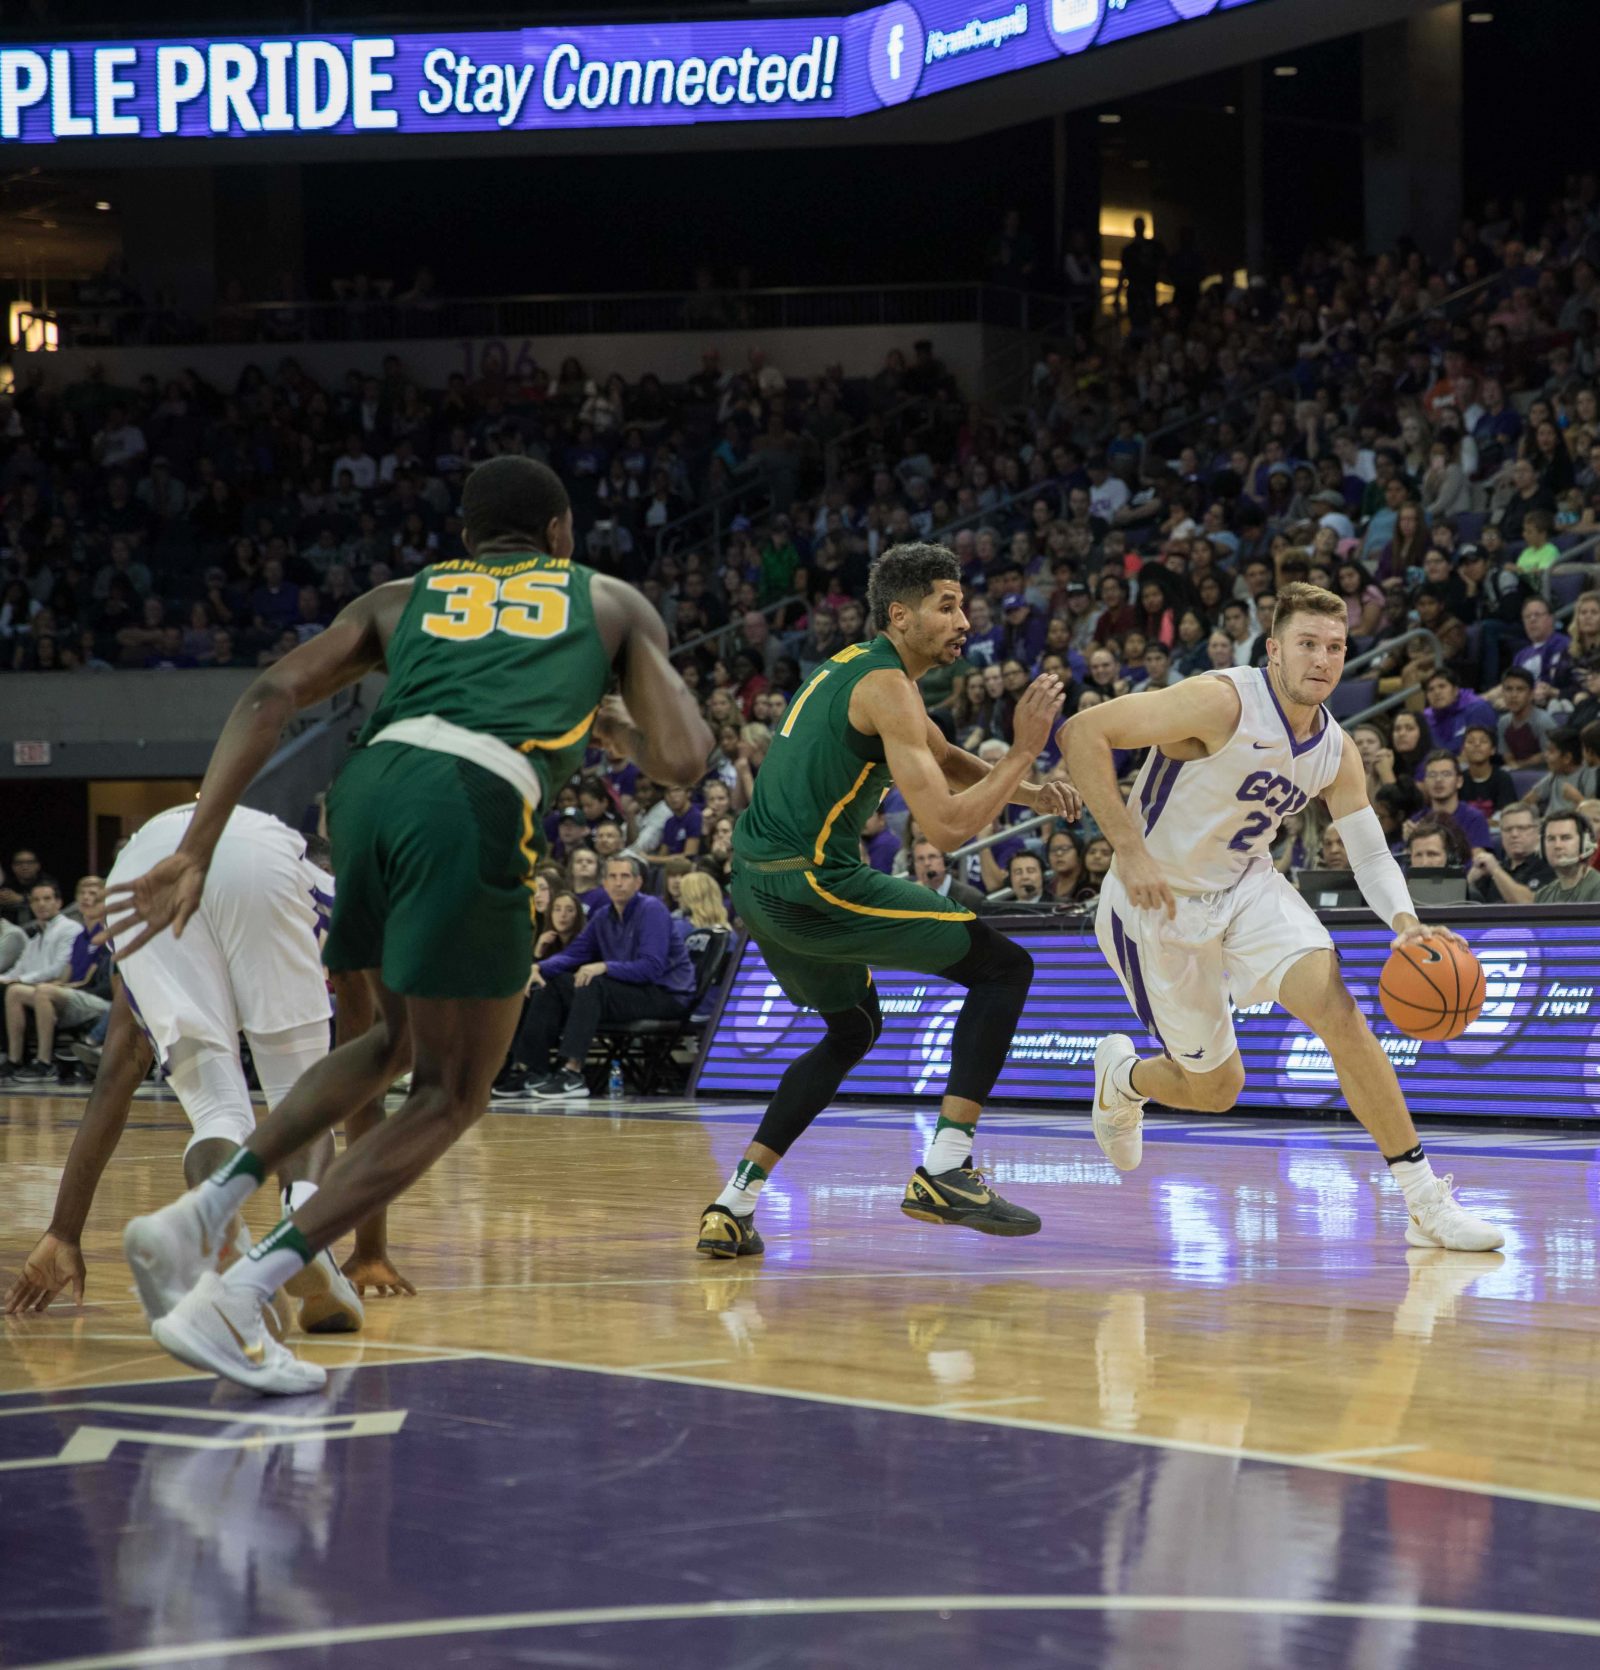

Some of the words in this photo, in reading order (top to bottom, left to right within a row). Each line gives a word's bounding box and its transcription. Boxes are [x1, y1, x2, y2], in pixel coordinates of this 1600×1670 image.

[0, 47, 139, 138] PLE
[157, 39, 398, 134] PRIDE
[419, 48, 531, 126] Stay
[543, 35, 839, 111] Connected!
[421, 570, 570, 641] 35
[780, 669, 831, 738] 1
[1235, 770, 1308, 817] GCU
[1228, 811, 1273, 852] 2
